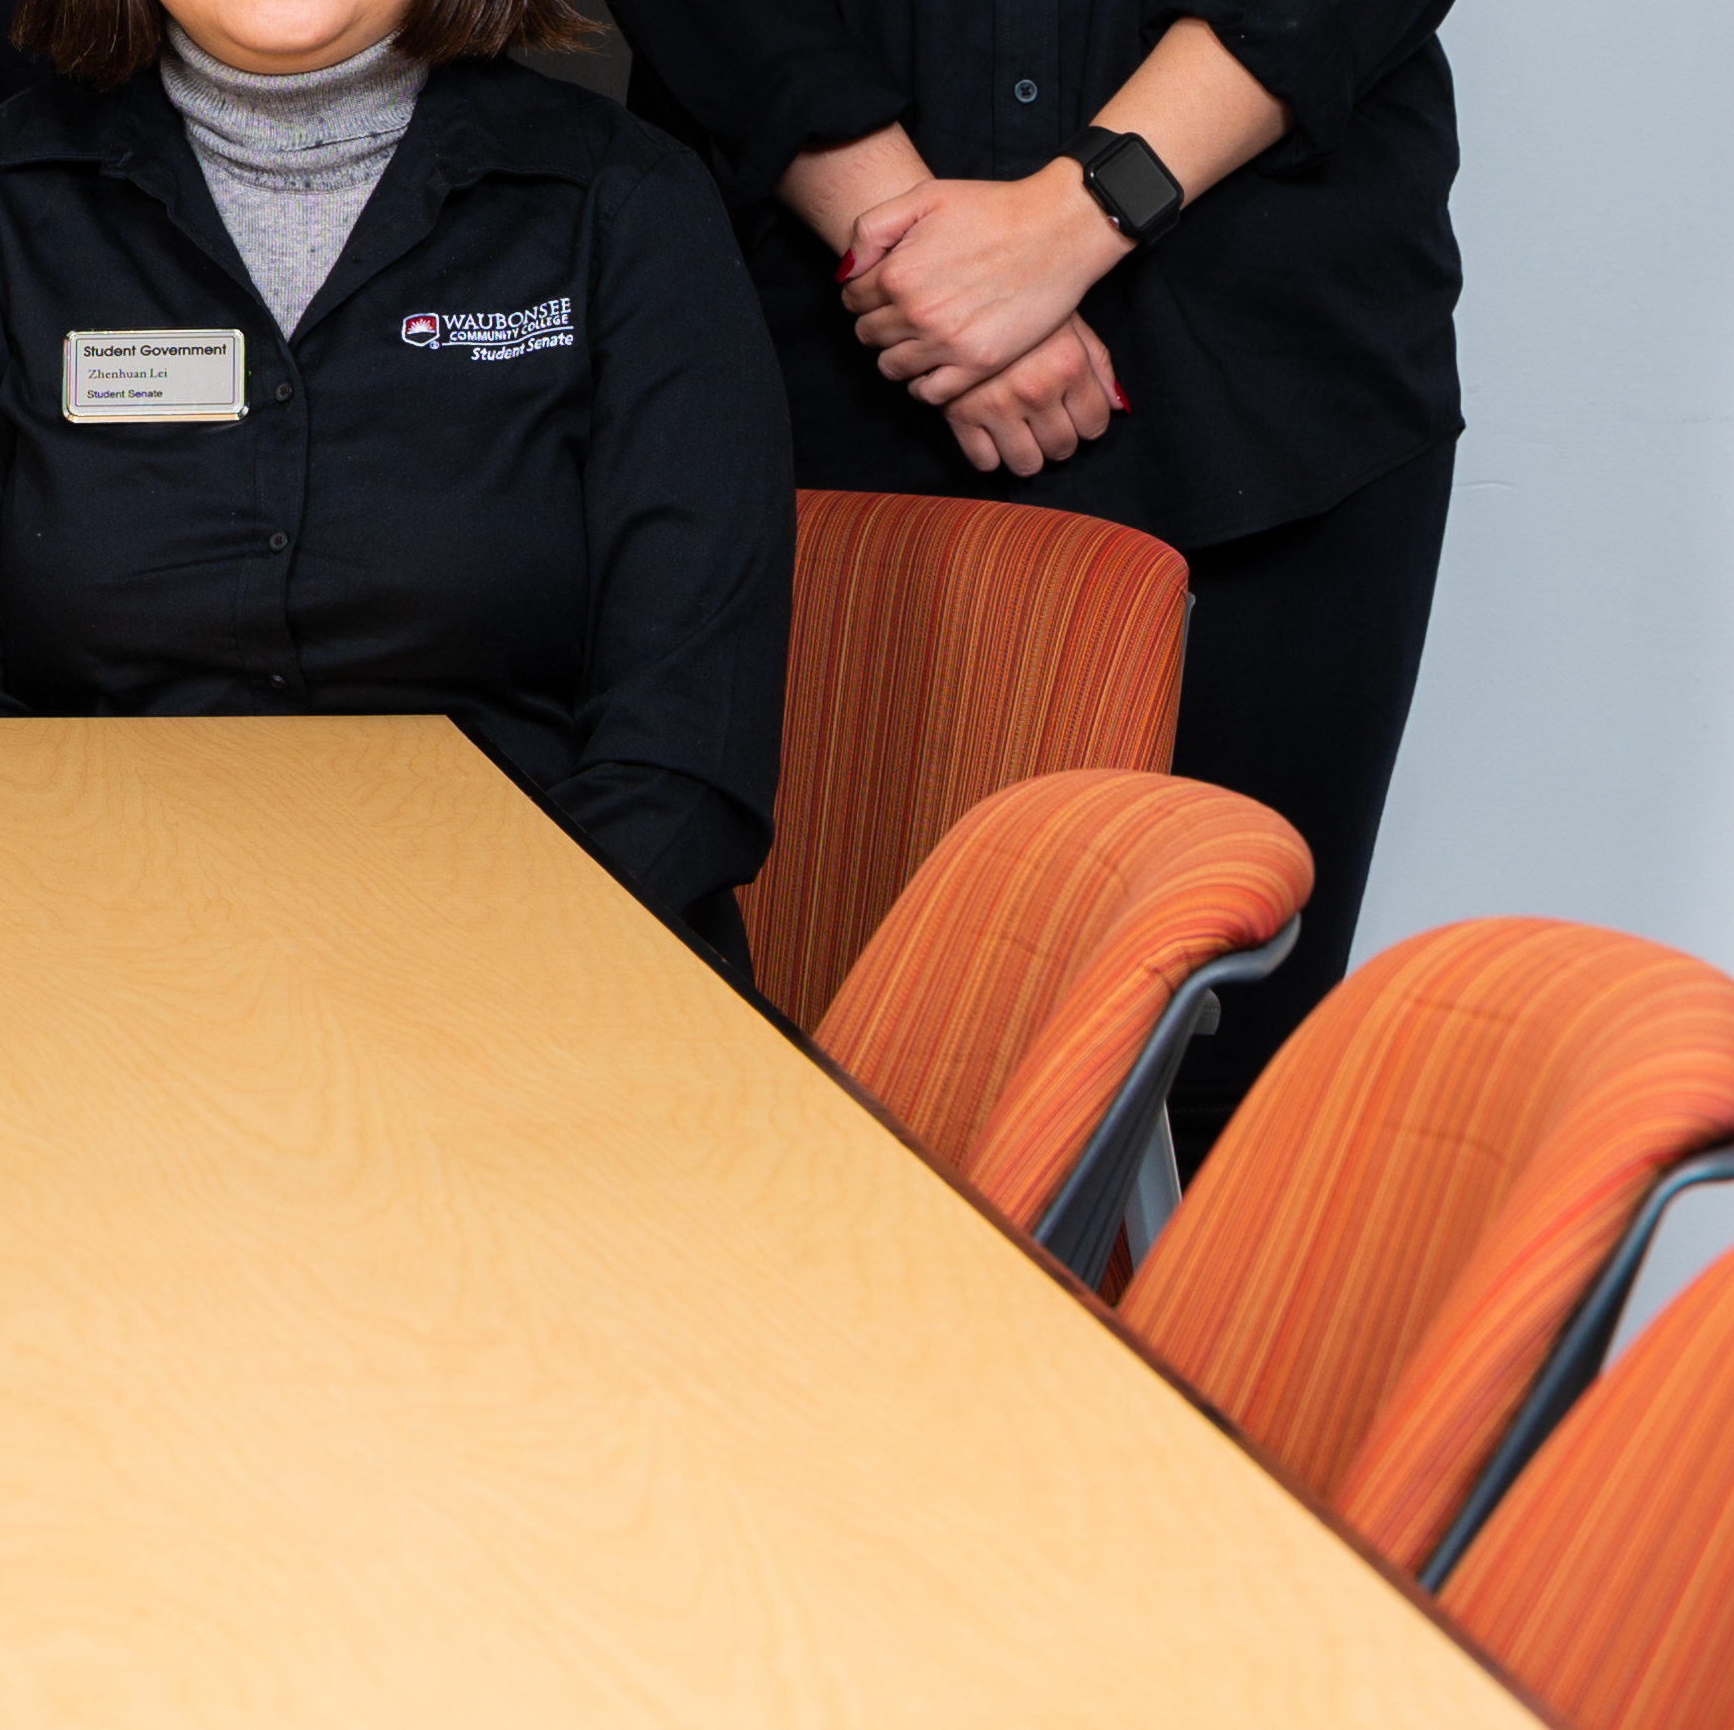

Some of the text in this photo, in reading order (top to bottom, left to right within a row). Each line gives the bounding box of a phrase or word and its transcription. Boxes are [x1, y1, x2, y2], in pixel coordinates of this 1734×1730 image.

[442, 298, 571, 330] WAUBONSEE
[450, 313, 568, 341] COMMUNITY COLLEGE
[84, 344, 227, 357] Student Government
[471, 333, 573, 361] Student Senate
[150, 368, 168, 378] Lei
[87, 390, 163, 399] Student Senate
